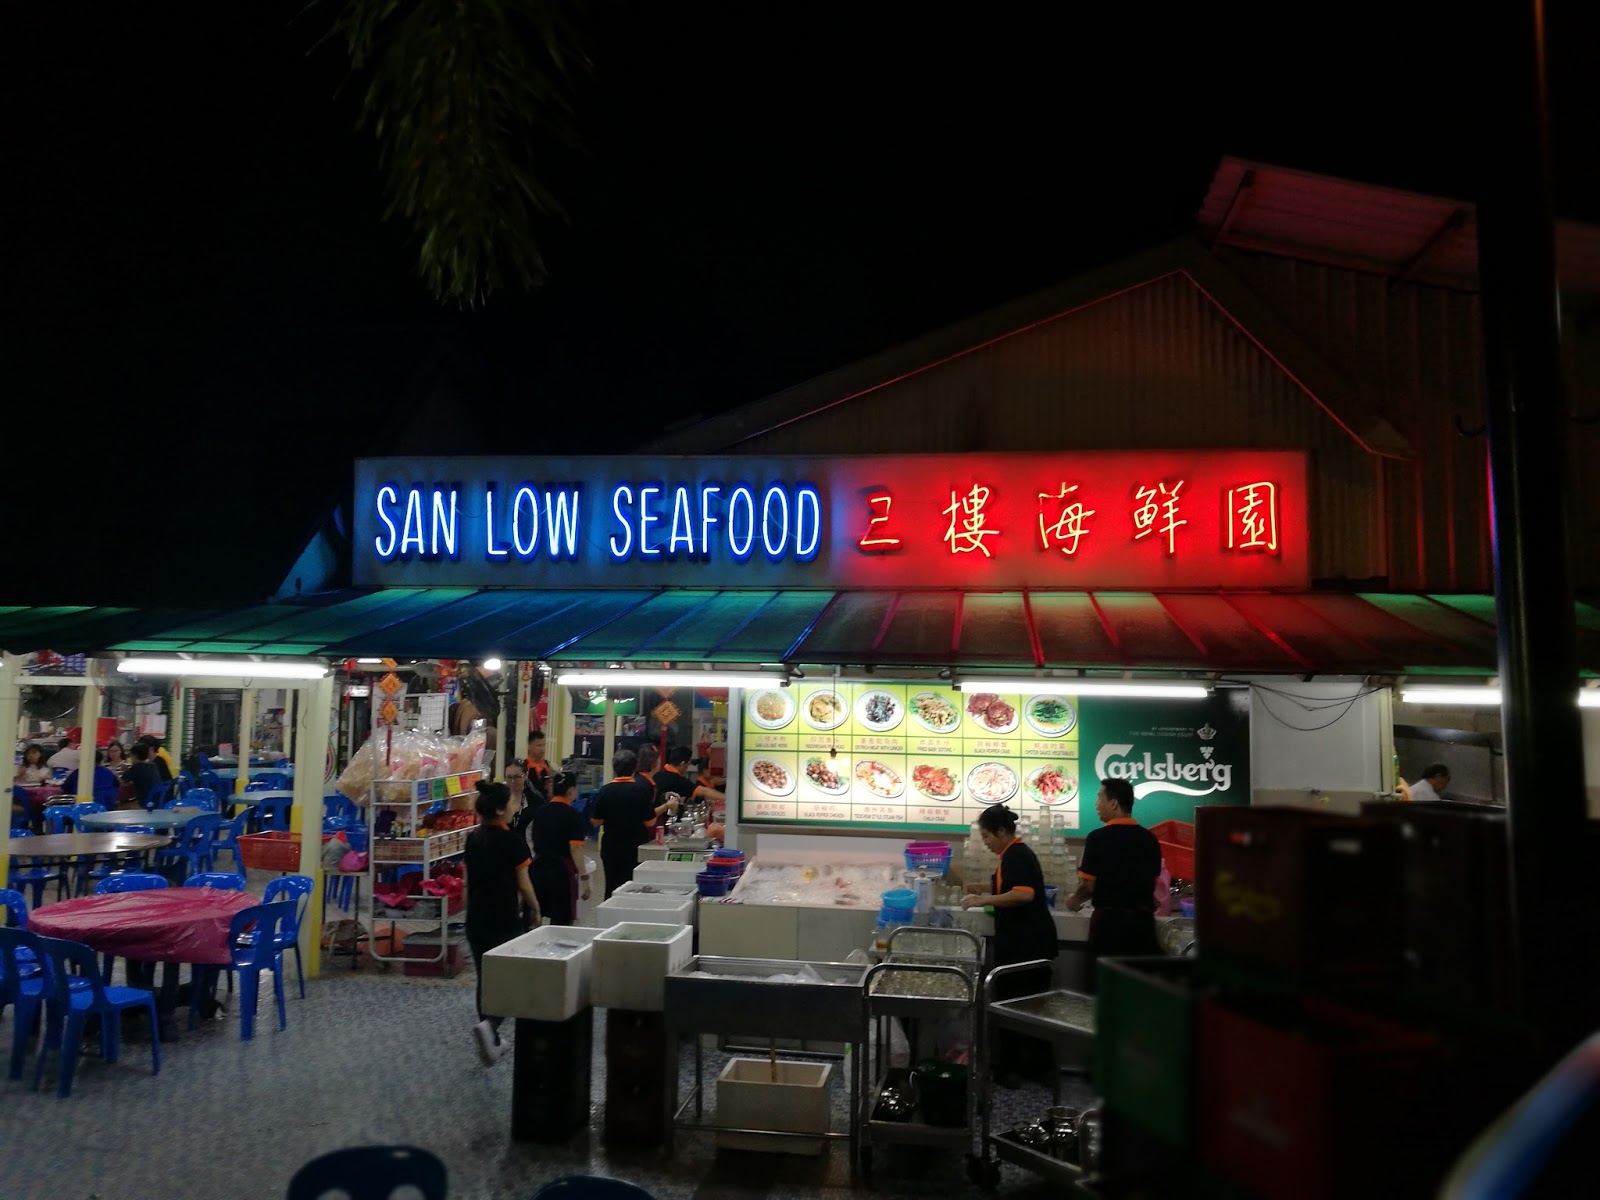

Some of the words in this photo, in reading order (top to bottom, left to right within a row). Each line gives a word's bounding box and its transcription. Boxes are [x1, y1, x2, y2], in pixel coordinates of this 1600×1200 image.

[375, 485, 457, 557] SAN
[485, 486, 580, 557] LOW
[609, 485, 821, 557] SEAFOOD
[1094, 743, 1232, 792] Carlsberg
